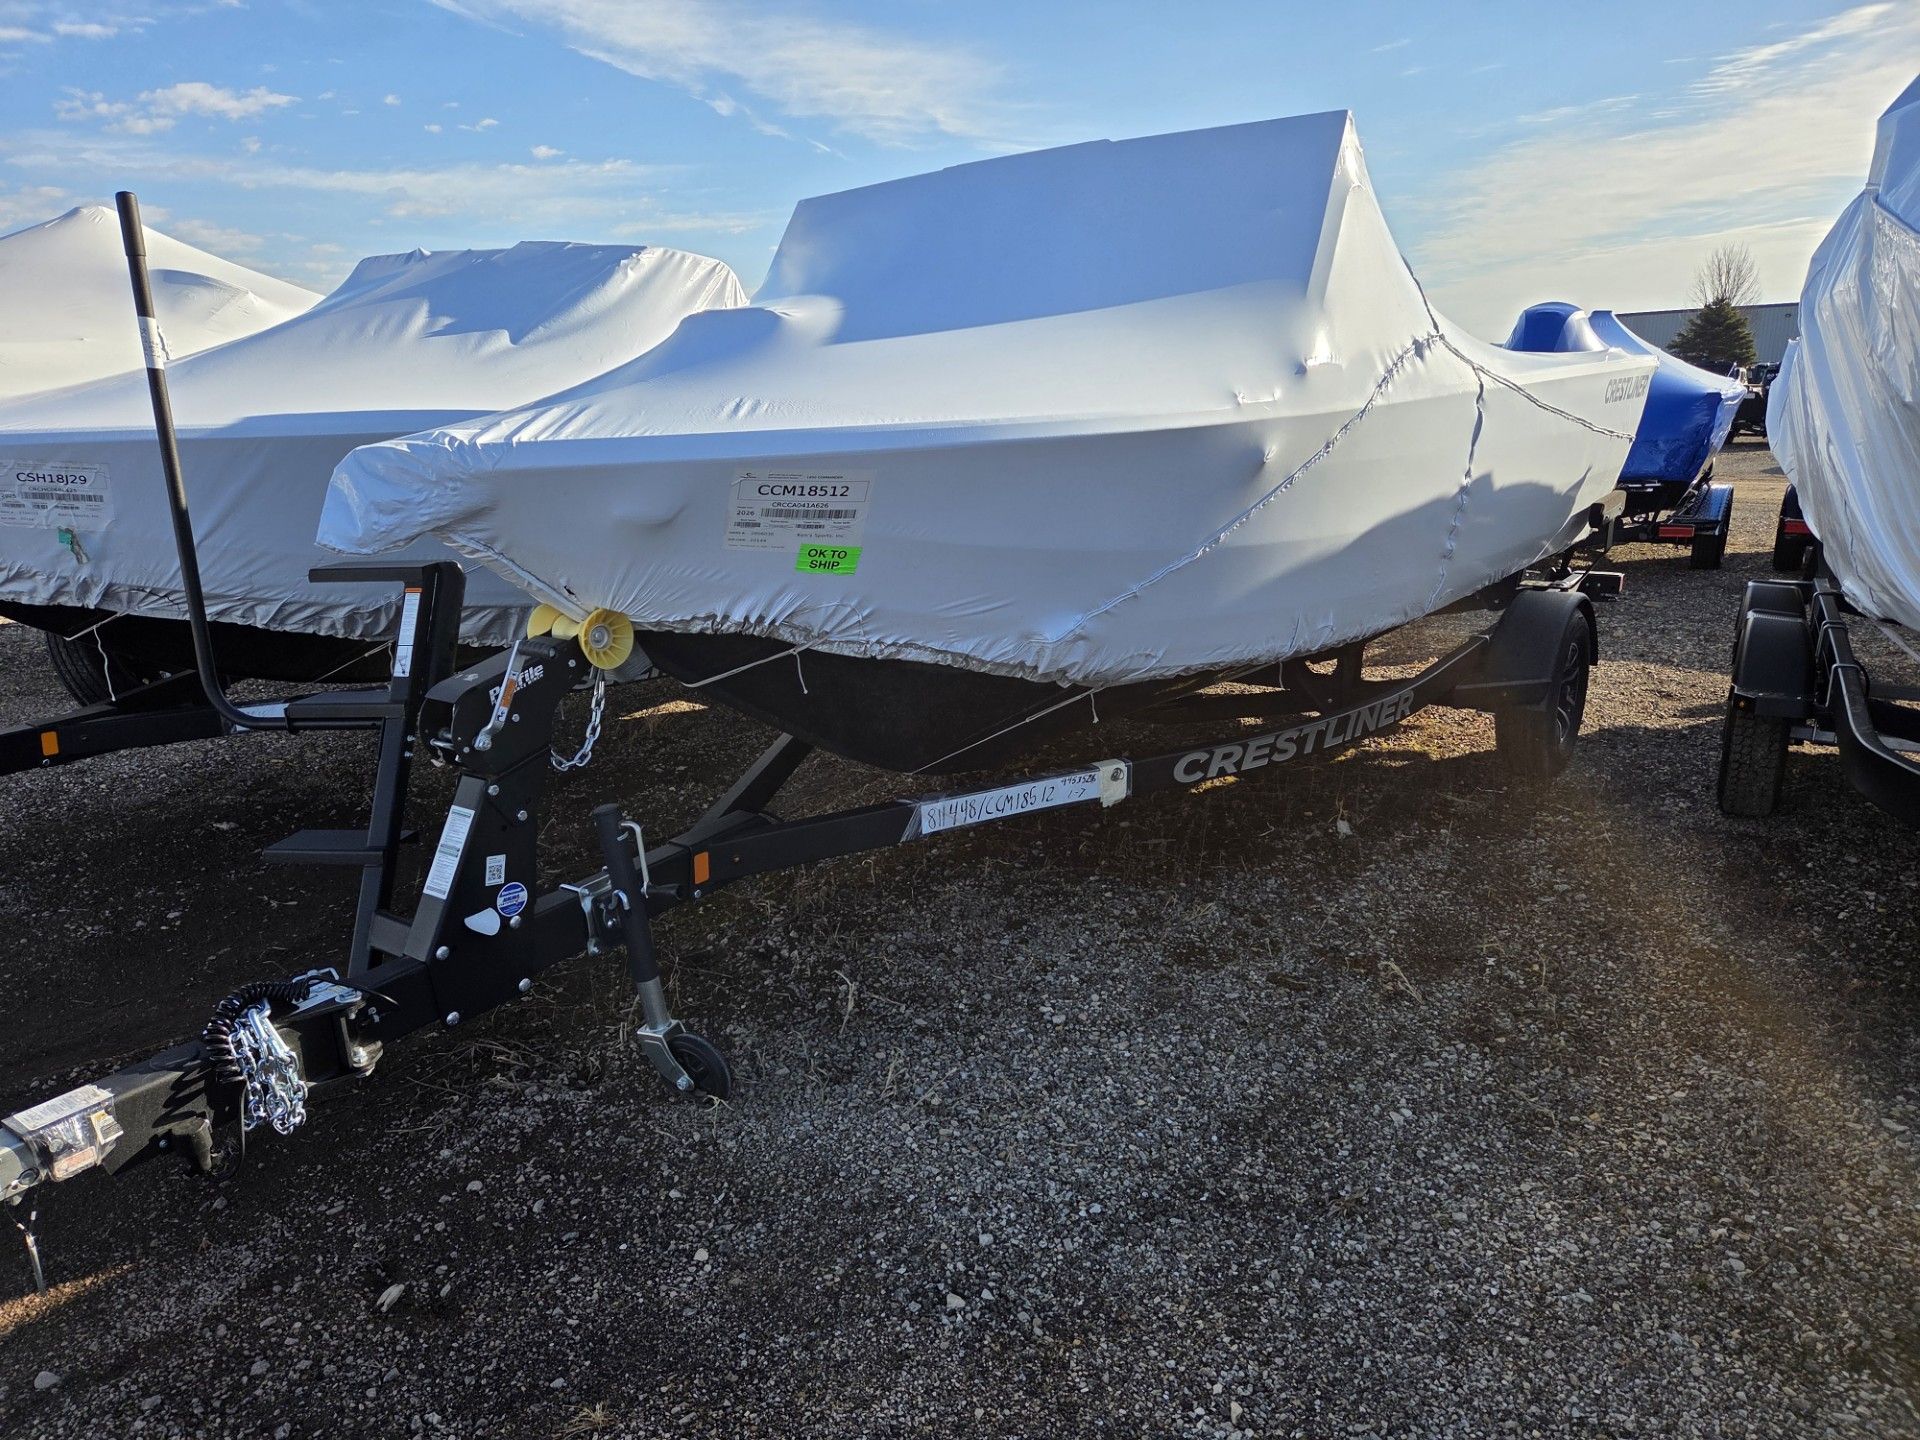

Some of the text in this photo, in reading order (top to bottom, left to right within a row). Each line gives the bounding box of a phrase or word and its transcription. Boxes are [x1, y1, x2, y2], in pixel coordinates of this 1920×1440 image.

[1605, 374, 1649, 404] CRESTLINER
[16, 472, 87, 486] CSH18J29
[758, 485, 850, 497] CCM18512
[807, 548, 848, 560] OK TO
[809, 560, 840, 569] SHIP
[488, 664, 544, 705] Pfile
[1172, 690, 1414, 783] CRESTLINER
